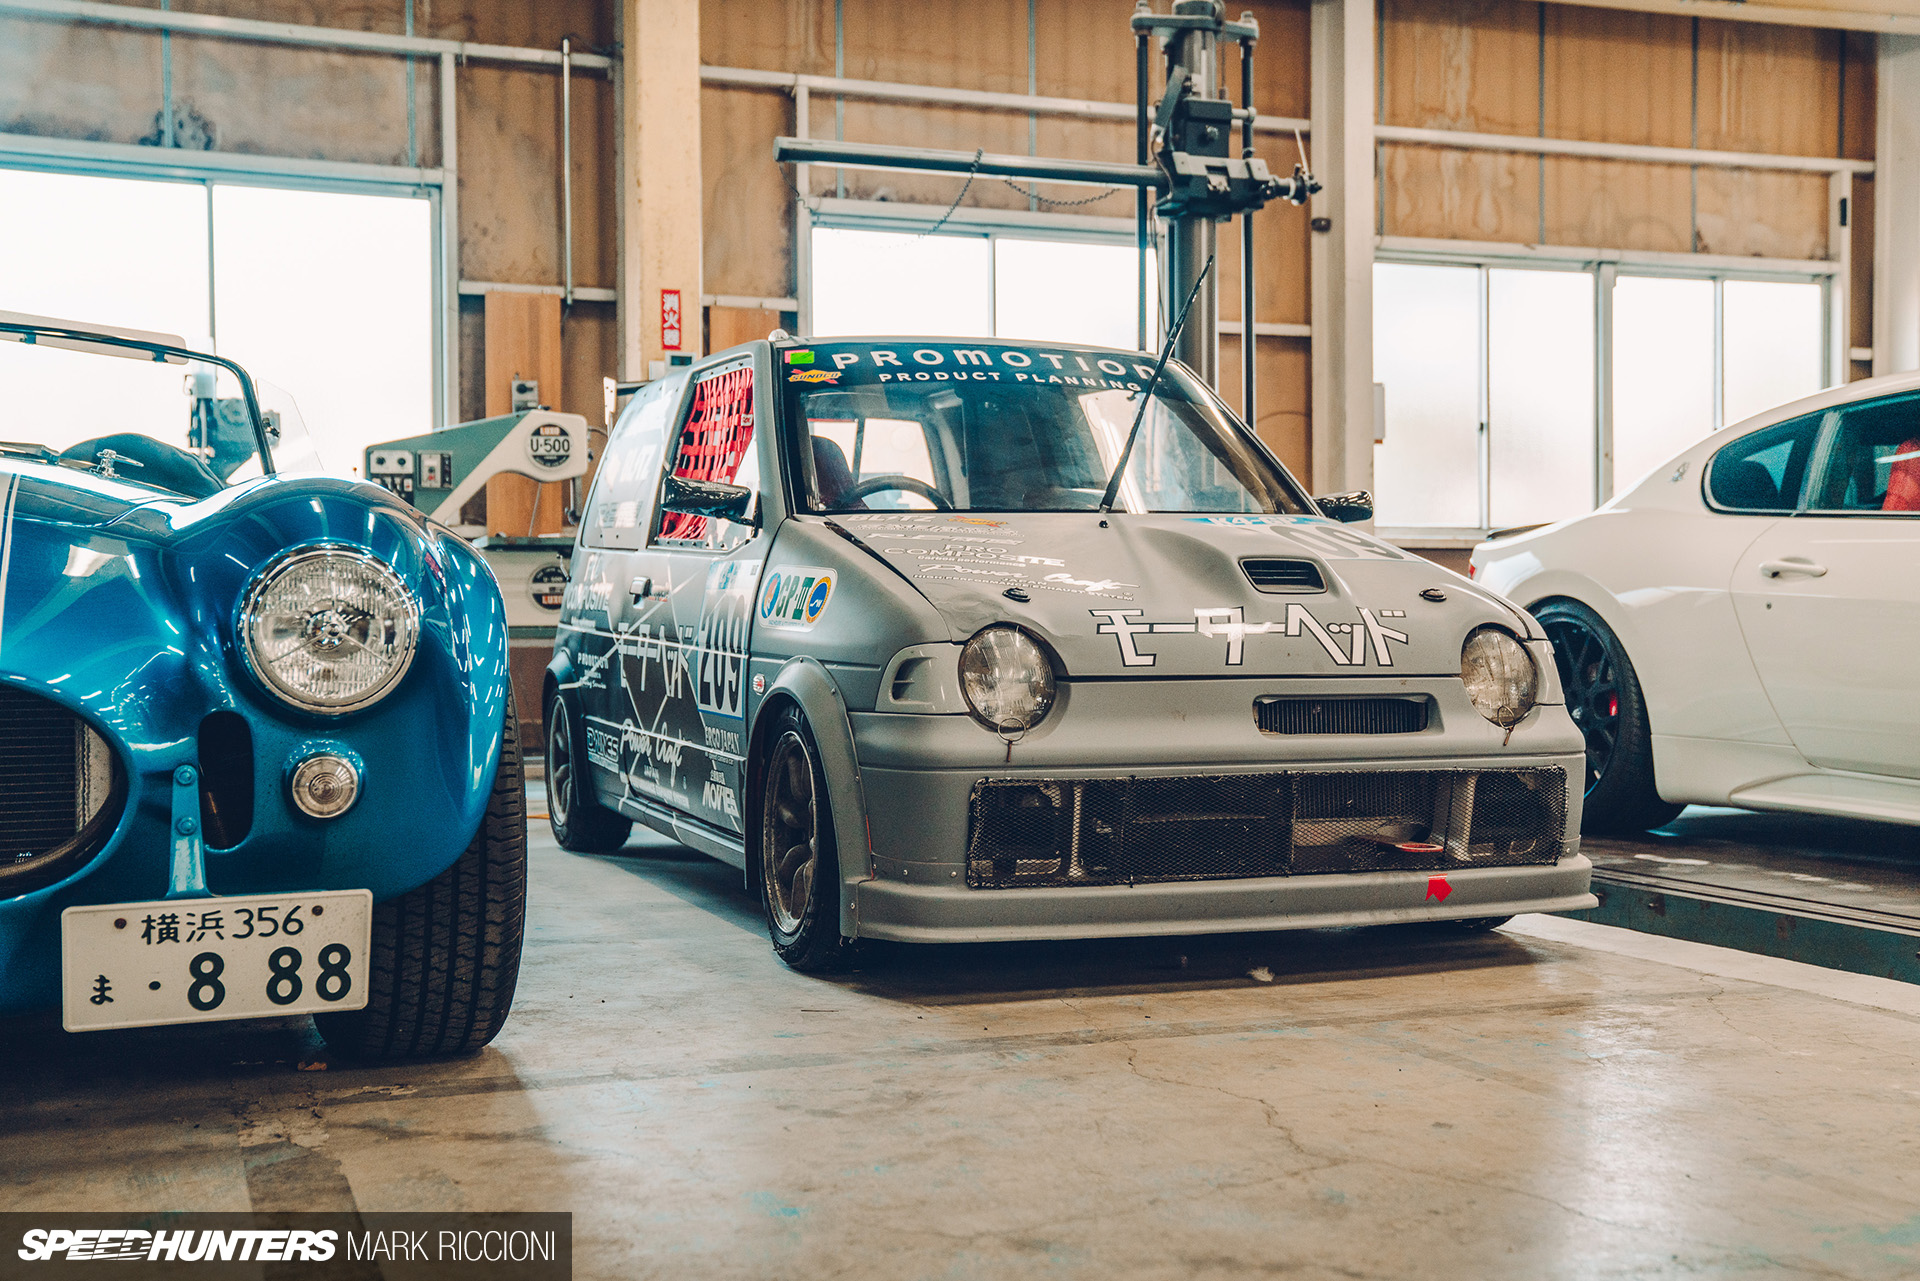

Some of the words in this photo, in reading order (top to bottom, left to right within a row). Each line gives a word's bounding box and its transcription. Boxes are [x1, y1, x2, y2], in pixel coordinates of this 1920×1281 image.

[878, 371, 1001, 383] PRODUCT
[1017, 373, 1142, 392] PLANNING
[847, 514, 937, 523] BLITZ
[884, 547, 1066, 568] COMPOSITE
[944, 544, 1009, 554] PRO
[699, 593, 745, 713] 209
[89, 974, 115, 1006] ま
